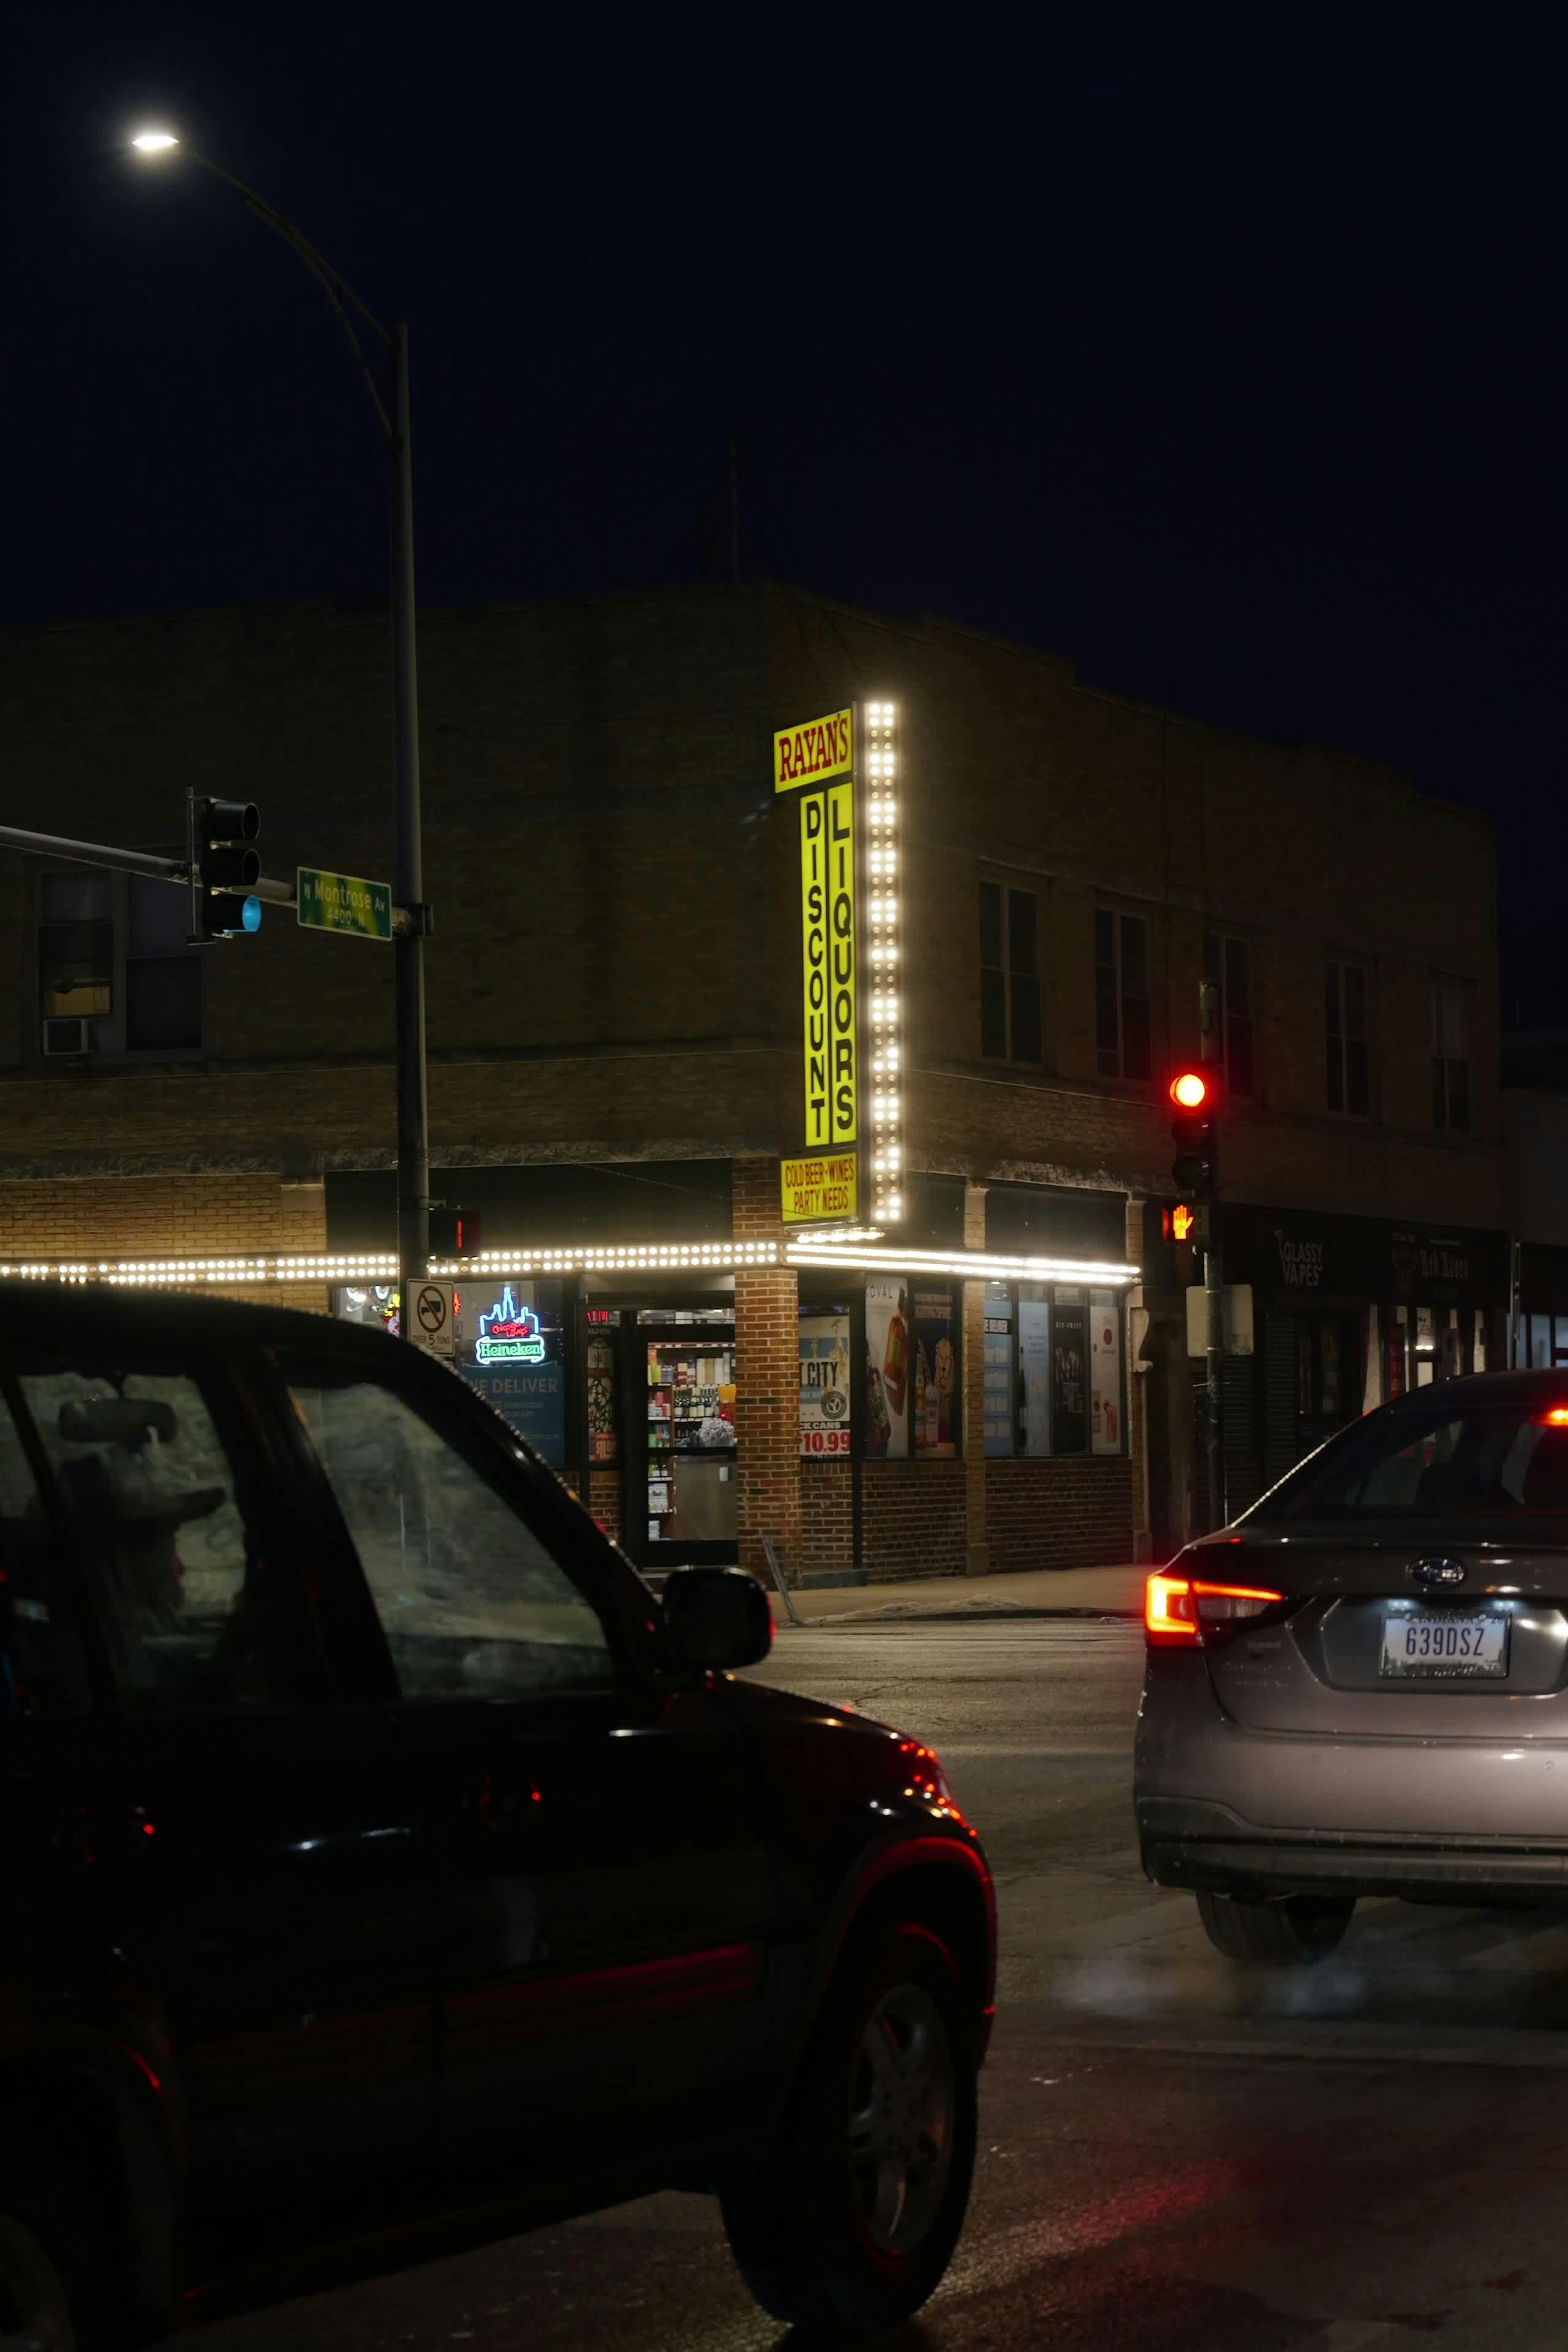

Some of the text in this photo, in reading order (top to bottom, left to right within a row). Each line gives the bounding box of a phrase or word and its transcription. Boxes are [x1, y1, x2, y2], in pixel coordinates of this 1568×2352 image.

[779, 713, 848, 782] RAYAN'S
[315, 878, 372, 910] Montrose
[327, 907, 364, 927] 4400 N
[806, 800, 826, 1137] DISCOUNT
[832, 799, 853, 1131] LIQUORS
[786, 1157, 853, 1188] COLD BEER WINES
[794, 1186, 848, 1213] PARTY NEEDS
[1283, 1242, 1323, 1264] GLASSY
[1283, 1262, 1322, 1286] VAPES
[412, 1333, 451, 1346] OVER 5 TONS
[480, 1342, 541, 1356] Heineken
[492, 1378, 559, 1393] DELIVER
[808, 1362, 838, 1387] CITY
[804, 1432, 851, 1452] 10.99
[1406, 1627, 1485, 1656] 639DSZ
